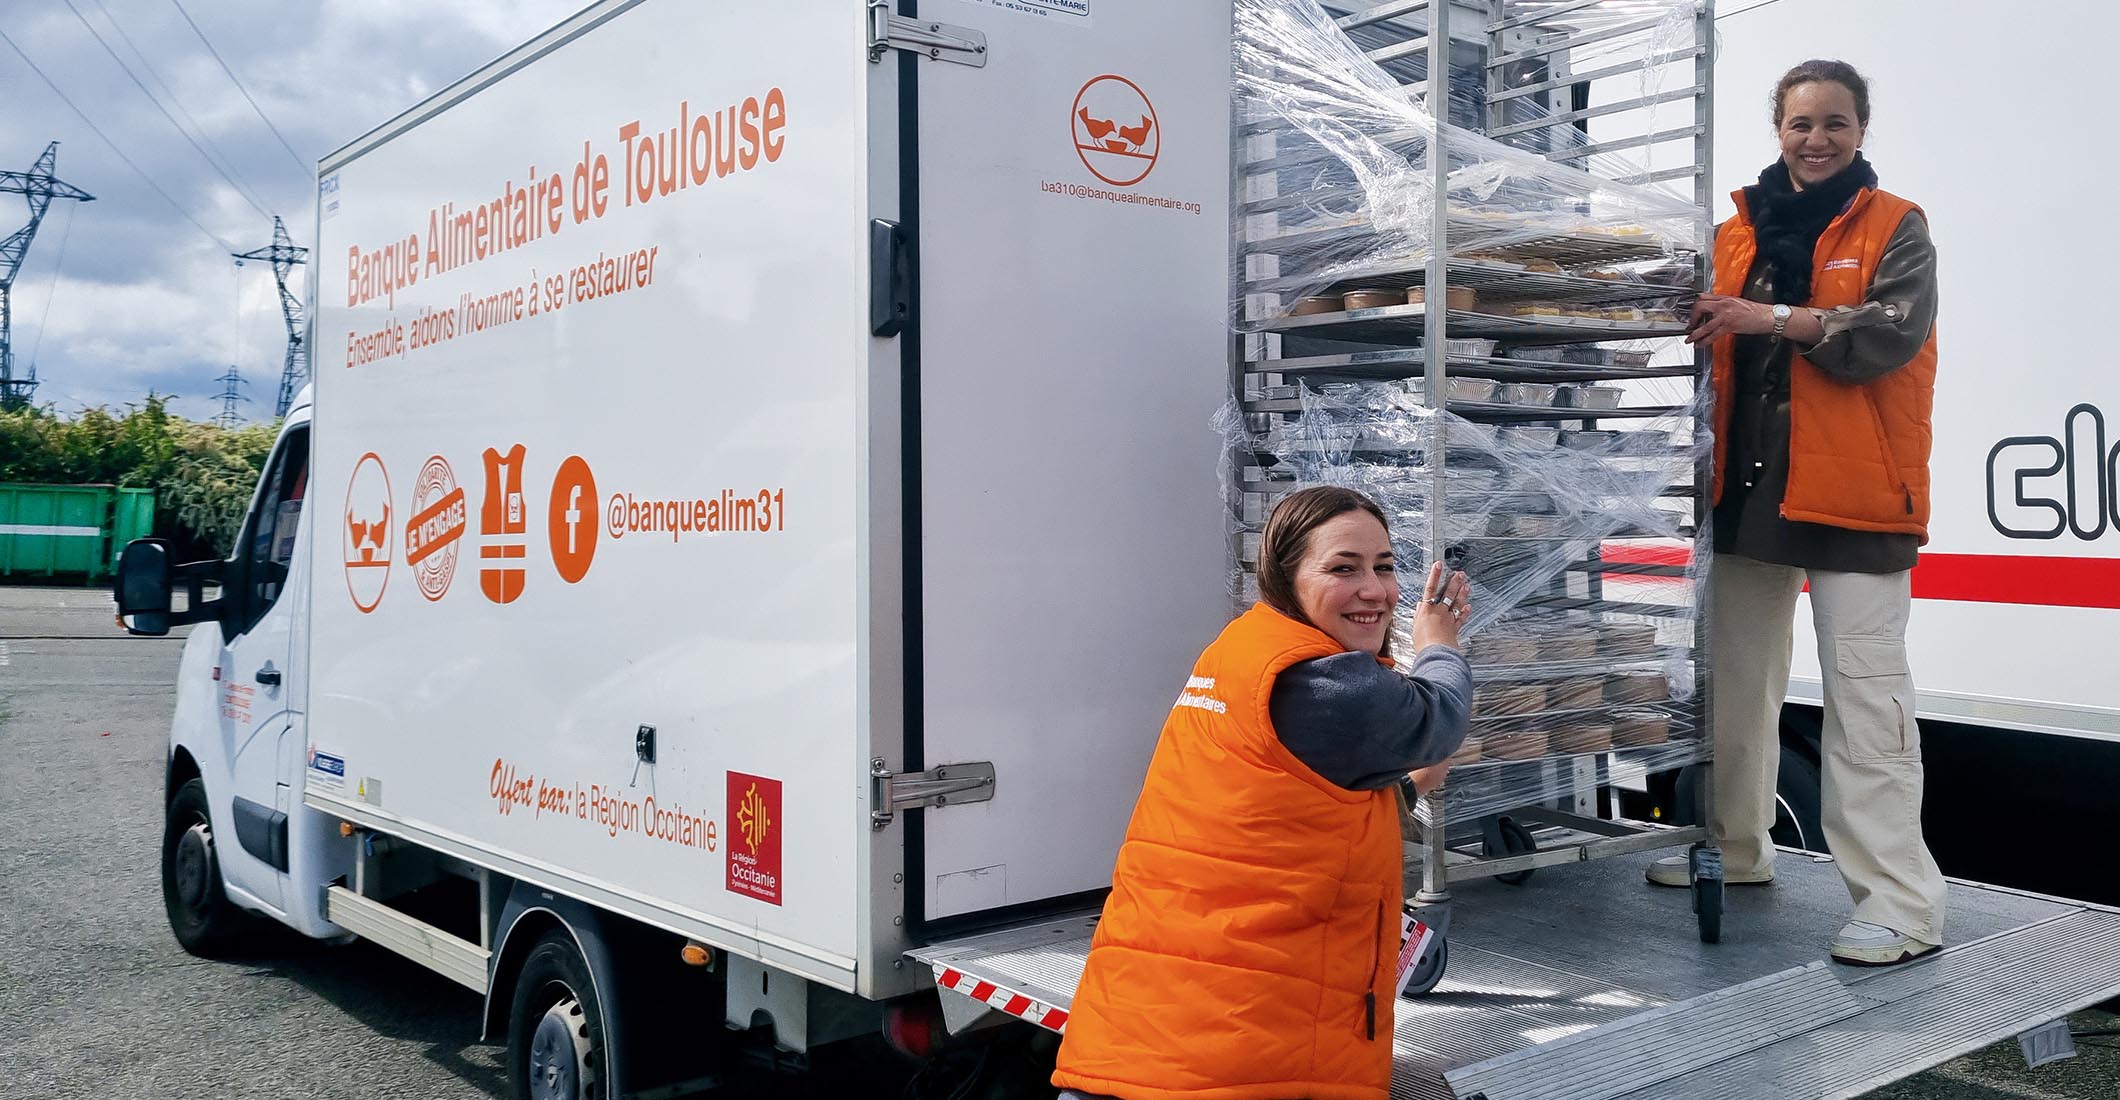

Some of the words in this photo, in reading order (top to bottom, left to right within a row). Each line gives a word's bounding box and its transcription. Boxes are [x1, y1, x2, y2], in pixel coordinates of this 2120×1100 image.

[347, 233, 419, 310] Banque
[424, 166, 563, 280] Alimentaire
[572, 140, 609, 225] de
[618, 87, 786, 207] Toulouse
[1041, 180, 1201, 215] ba310@banquealimentaire.org
[346, 319, 406, 368] Ensemble,
[410, 303, 454, 351] aidons
[457, 290, 523, 337] l'homme
[528, 268, 538, 316] à
[543, 272, 564, 312] se
[568, 244, 658, 305] restaurer
[1986, 402, 2120, 541] cl
[406, 528, 418, 557] JE
[418, 498, 465, 549] M'ENGAGE
[607, 488, 784, 543] @banquealim31
[490, 758, 534, 816] Offert
[536, 778, 572, 821] par:
[575, 781, 587, 819] la
[590, 784, 639, 838] Région
[644, 796, 717, 852] Occitanie
[731, 863, 775, 887] Occitanie
[732, 851, 738, 860] La
